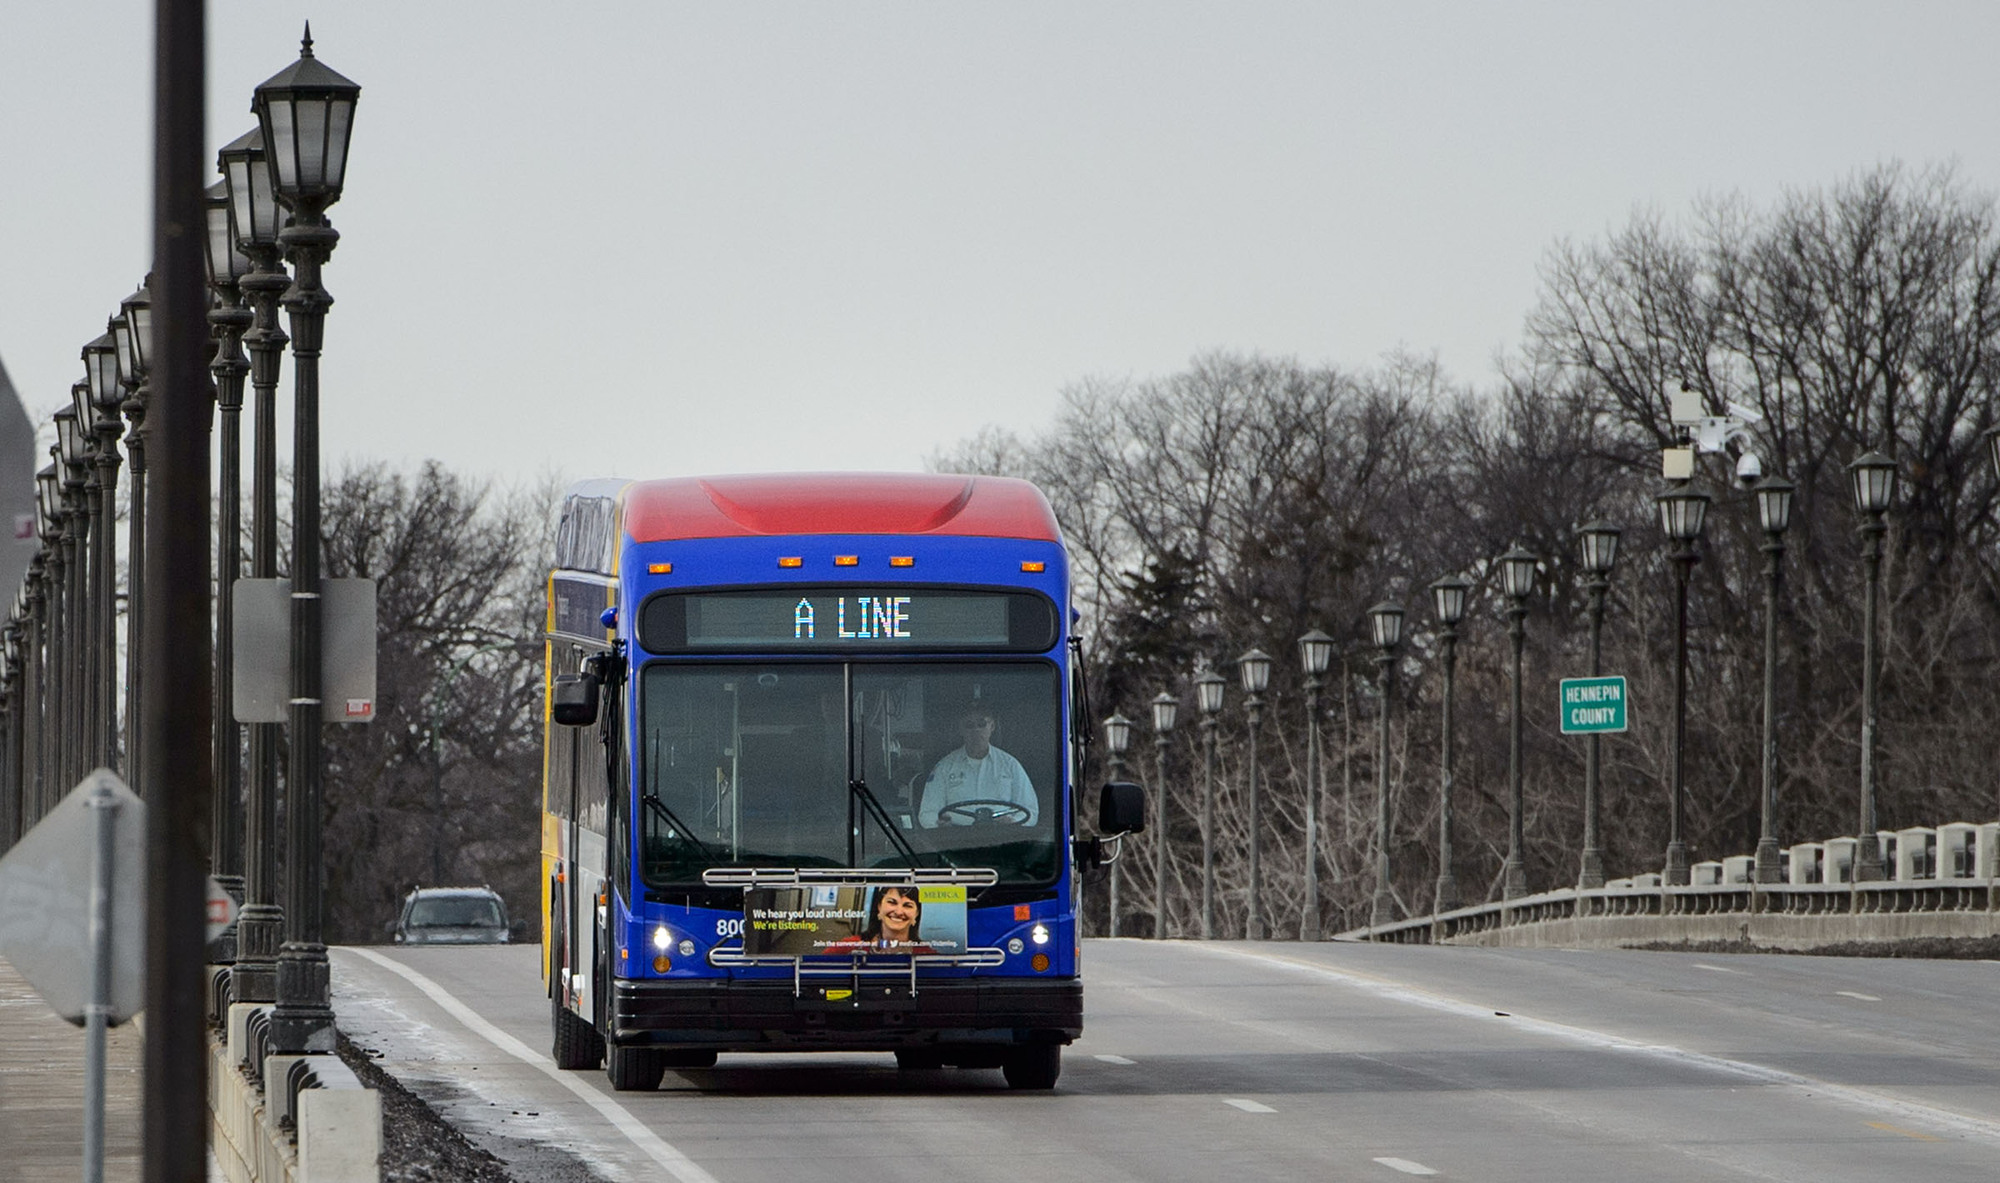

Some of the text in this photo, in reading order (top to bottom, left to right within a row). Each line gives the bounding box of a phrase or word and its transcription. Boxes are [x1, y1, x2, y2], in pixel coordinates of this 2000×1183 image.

[795, 597, 911, 638] A LINE
[1566, 685, 1620, 703] HENNEPIN
[1571, 707, 1616, 725] COUNTY
[924, 891, 960, 899] MEDICA
[753, 908, 866, 920] We hear you loud and clear.
[753, 920, 819, 932] We're listening.
